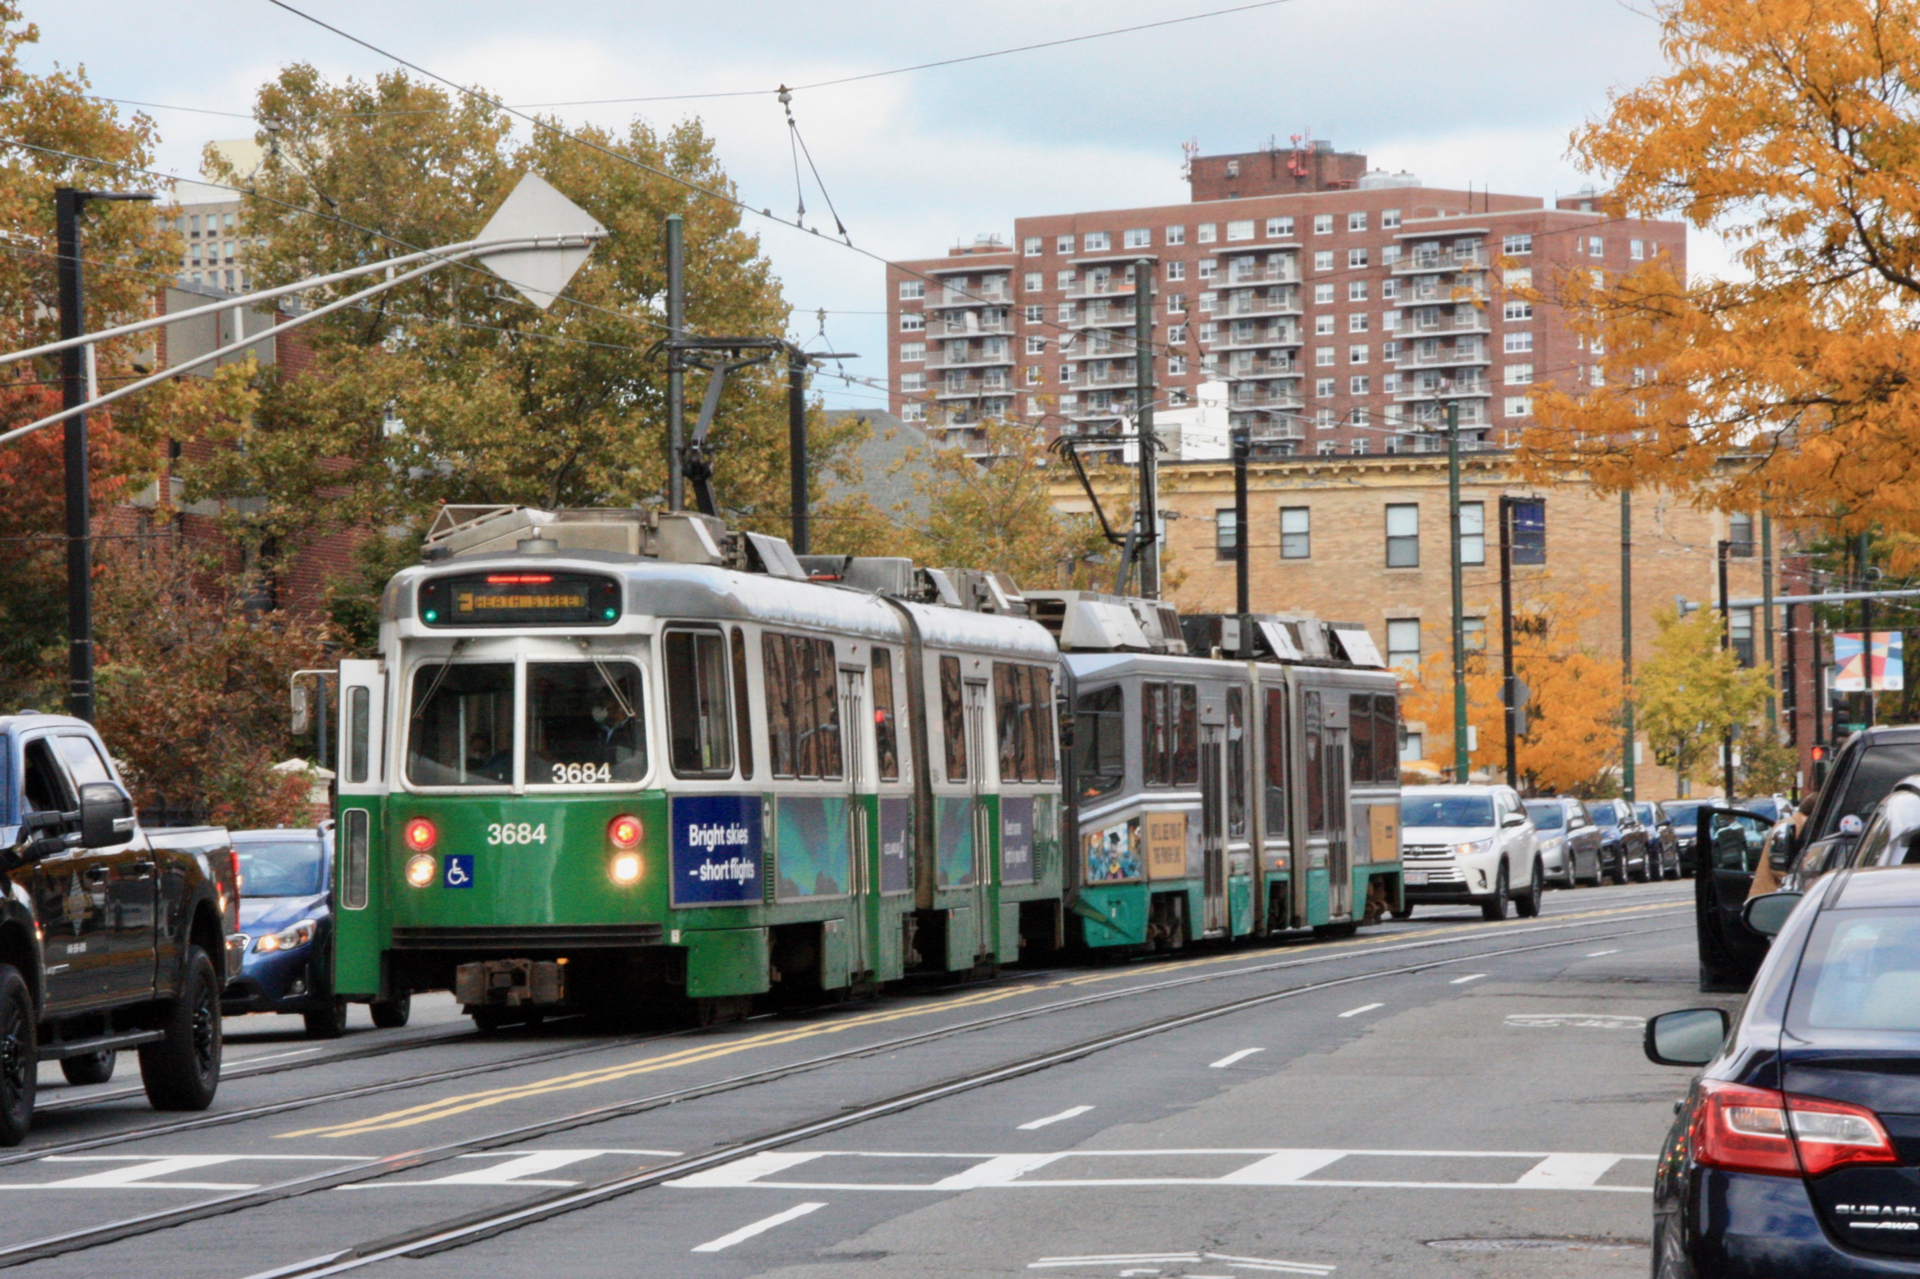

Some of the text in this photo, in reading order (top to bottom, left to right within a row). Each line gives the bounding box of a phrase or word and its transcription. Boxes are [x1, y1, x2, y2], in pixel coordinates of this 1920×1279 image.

[552, 762, 612, 784] 3684
[487, 823, 547, 845] 3684
[689, 823, 748, 852] Bright skies
[700, 858, 729, 881] short
[730, 857, 754, 885] flights
